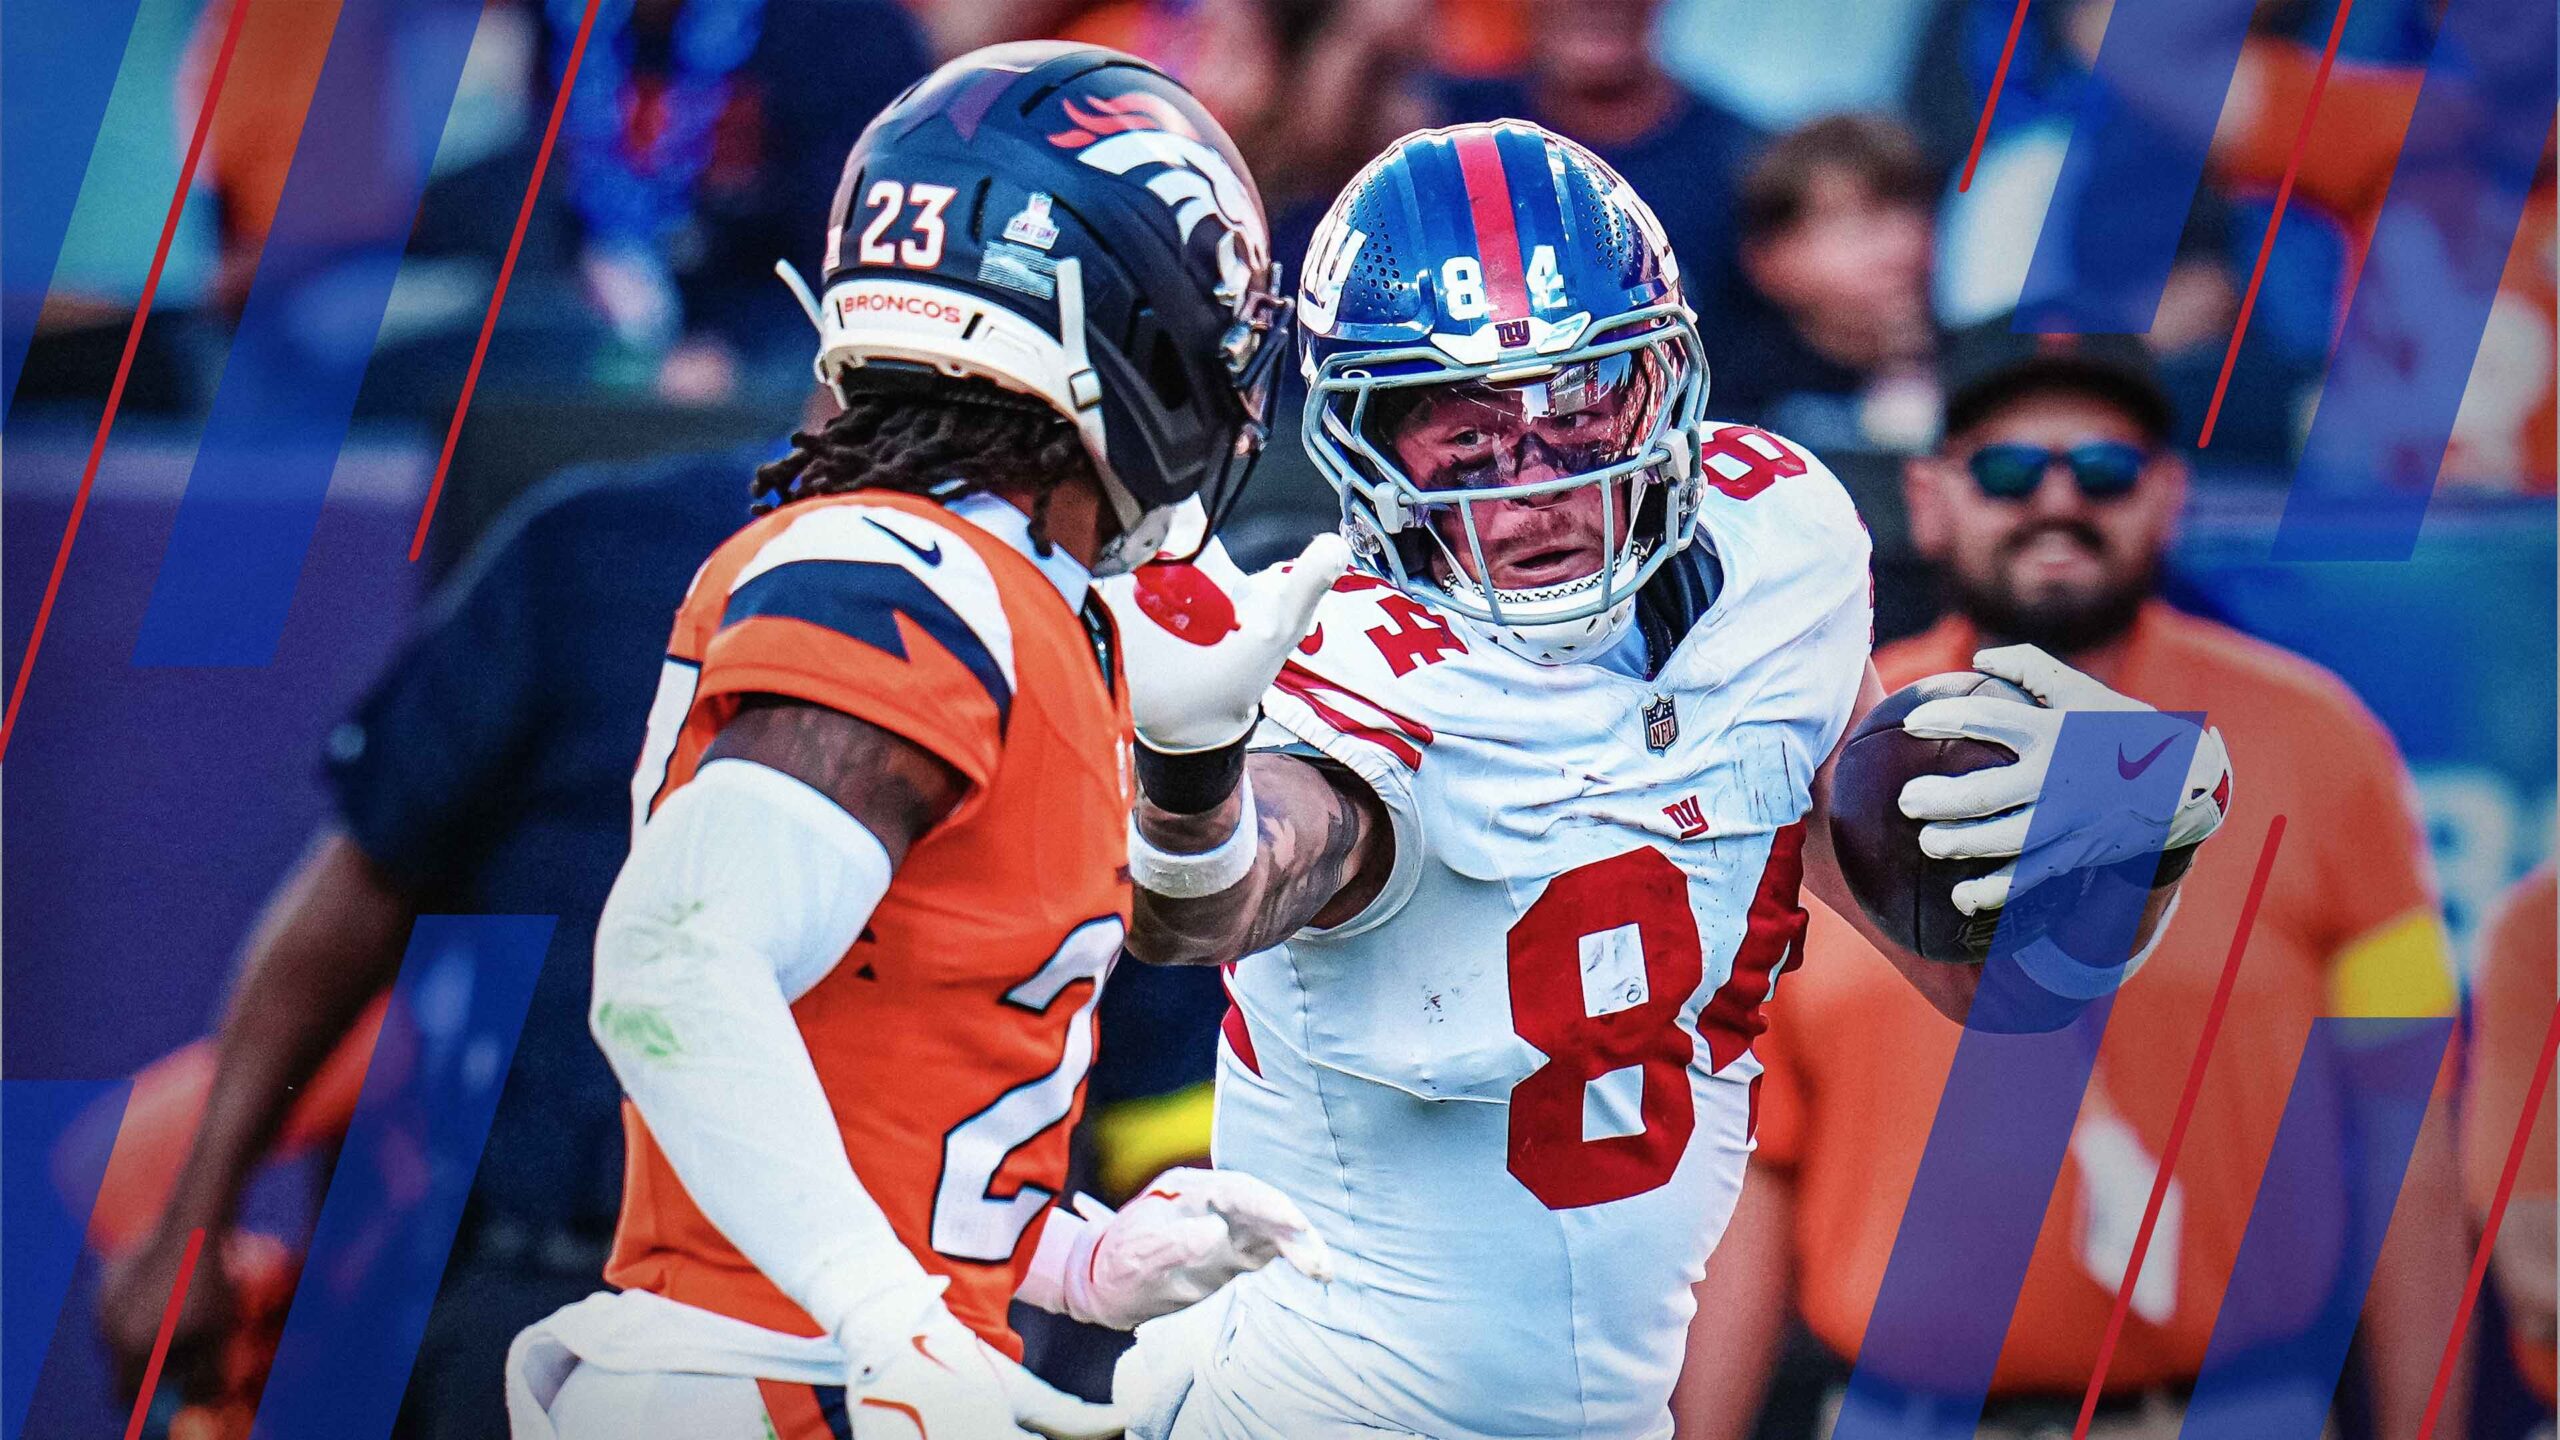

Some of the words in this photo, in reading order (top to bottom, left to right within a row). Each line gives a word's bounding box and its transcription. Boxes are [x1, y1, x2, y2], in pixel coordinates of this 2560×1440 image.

[860, 180, 957, 270] 23
[844, 294, 961, 324] BRONCOS
[1441, 245, 1567, 321] 84
[1651, 719, 1675, 746] NFL
